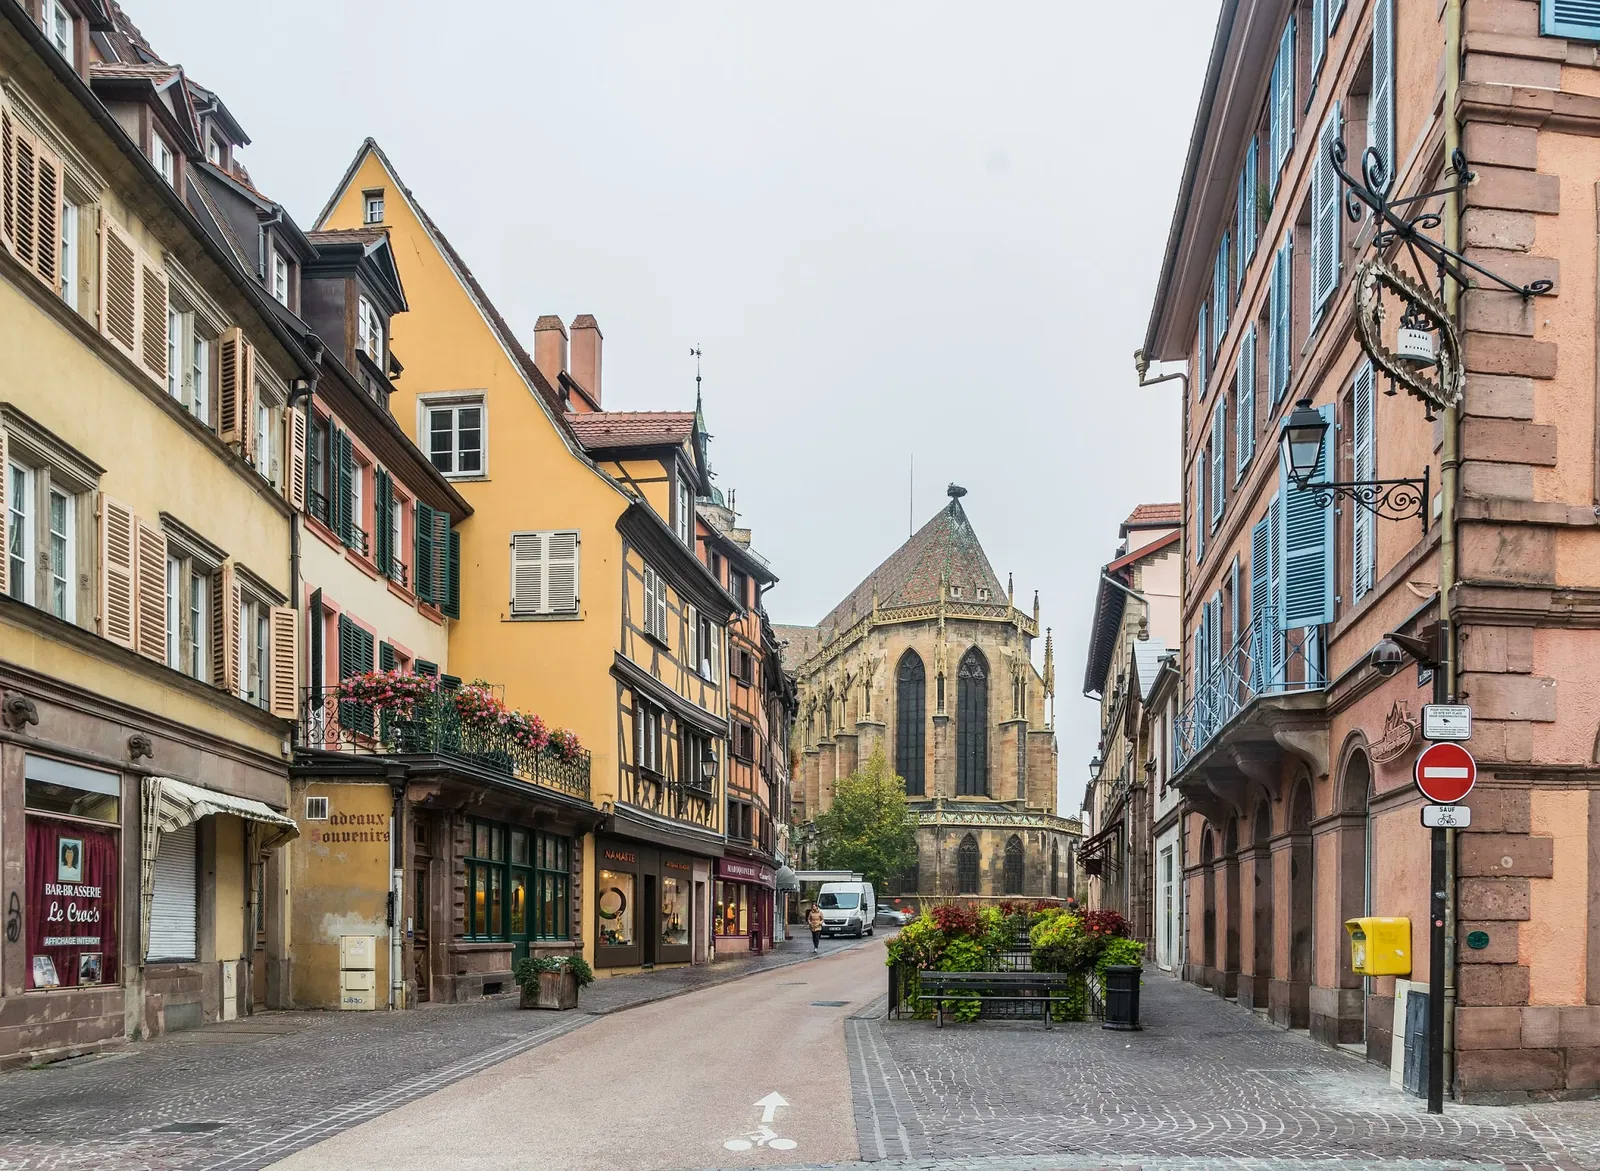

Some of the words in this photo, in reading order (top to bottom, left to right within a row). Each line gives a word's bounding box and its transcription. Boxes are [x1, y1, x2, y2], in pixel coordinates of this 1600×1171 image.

[328, 811, 385, 826] adeaux
[604, 849, 635, 863] NAMASTE
[45, 884, 101, 898] BAR-BRASSERIE
[47, 901, 64, 922] Le
[67, 902, 100, 923] Croc's
[45, 937, 76, 945] AFFICHAGE
[77, 937, 101, 945] INTERDIT
